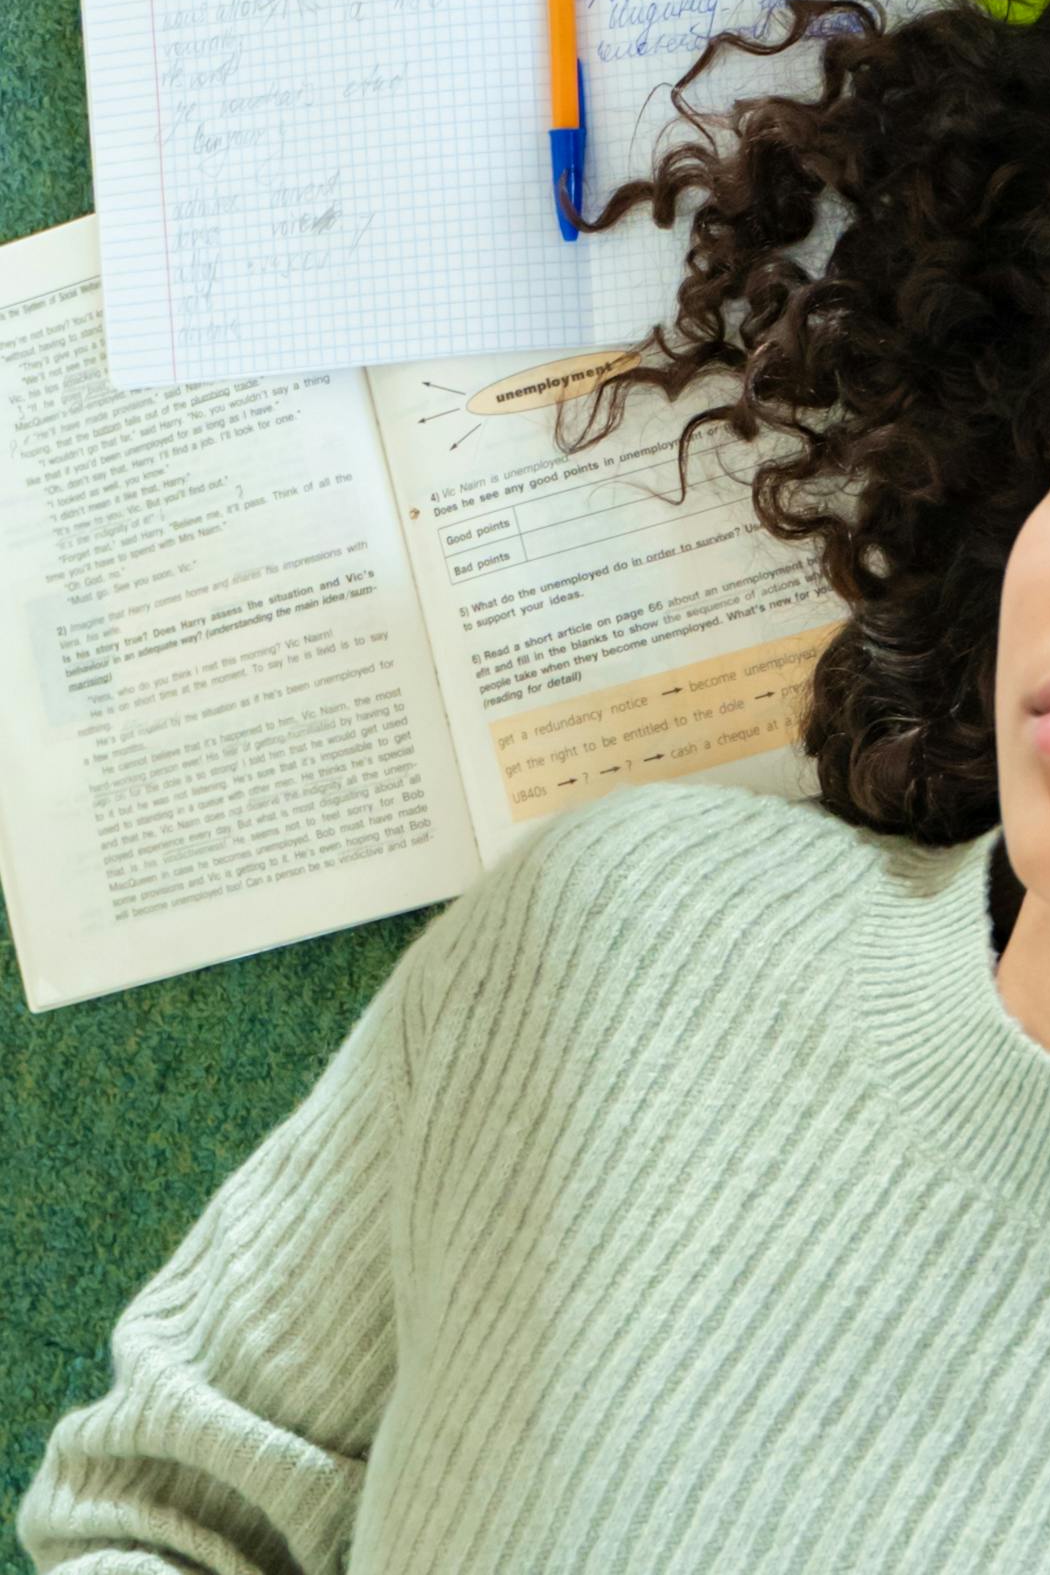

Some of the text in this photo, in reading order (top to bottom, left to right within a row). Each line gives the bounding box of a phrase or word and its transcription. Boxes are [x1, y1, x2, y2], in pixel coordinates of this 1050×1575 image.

[496, 362, 612, 403] unemployment
[433, 503, 457, 516] Does
[461, 498, 474, 507] he
[479, 491, 498, 502] see
[504, 484, 523, 494] any
[529, 472, 558, 489] good
[563, 462, 598, 479] points
[446, 520, 509, 545] Good points
[453, 553, 509, 575] Bad points
[471, 598, 497, 612] What
[501, 594, 514, 603] do
[518, 588, 535, 598] the
[540, 565, 609, 592] unemployed
[613, 562, 627, 571] do
[631, 557, 642, 566] in
[646, 548, 675, 562] order
[680, 543, 692, 552] to
[695, 527, 739, 548] survive?
[246, 600, 263, 610] the
[268, 586, 313, 604] situation
[319, 577, 340, 590] and
[275, 607, 291, 617] the
[294, 599, 318, 611] main
[463, 623, 472, 631] to
[476, 608, 515, 627] support
[520, 601, 542, 615] your
[483, 645, 509, 659] Read
[514, 643, 520, 651] a
[524, 632, 552, 648] short
[557, 622, 591, 638] article
[596, 617, 611, 627] on
[615, 608, 643, 623] page
[648, 600, 663, 612] 66
[668, 591, 699, 607] about
[705, 587, 717, 596] an
[722, 560, 803, 591] unemployment
[479, 678, 510, 694] people
[514, 670, 537, 682] take
[540, 660, 569, 673] when
[573, 652, 597, 664] they
[601, 638, 646, 657] become
[726, 604, 765, 620] What's
[769, 597, 791, 608] new
[794, 591, 808, 601] for
[494, 659, 513, 672] and
[516, 654, 529, 665] fill
[534, 652, 543, 660] in
[548, 646, 566, 656] the
[570, 634, 608, 650] blanks
[612, 629, 624, 638] to
[628, 620, 657, 633] show
[663, 614, 680, 623] the
[686, 596, 739, 617] sequence
[745, 589, 754, 599] of
[762, 579, 800, 595] actions
[483, 671, 581, 709] (reading for detail)
[498, 647, 816, 748] get a redundancy notice become unemployed
[505, 700, 744, 776] get the right to be entitled to the dole
[512, 718, 791, 803] UB40s cash a cheque at a
